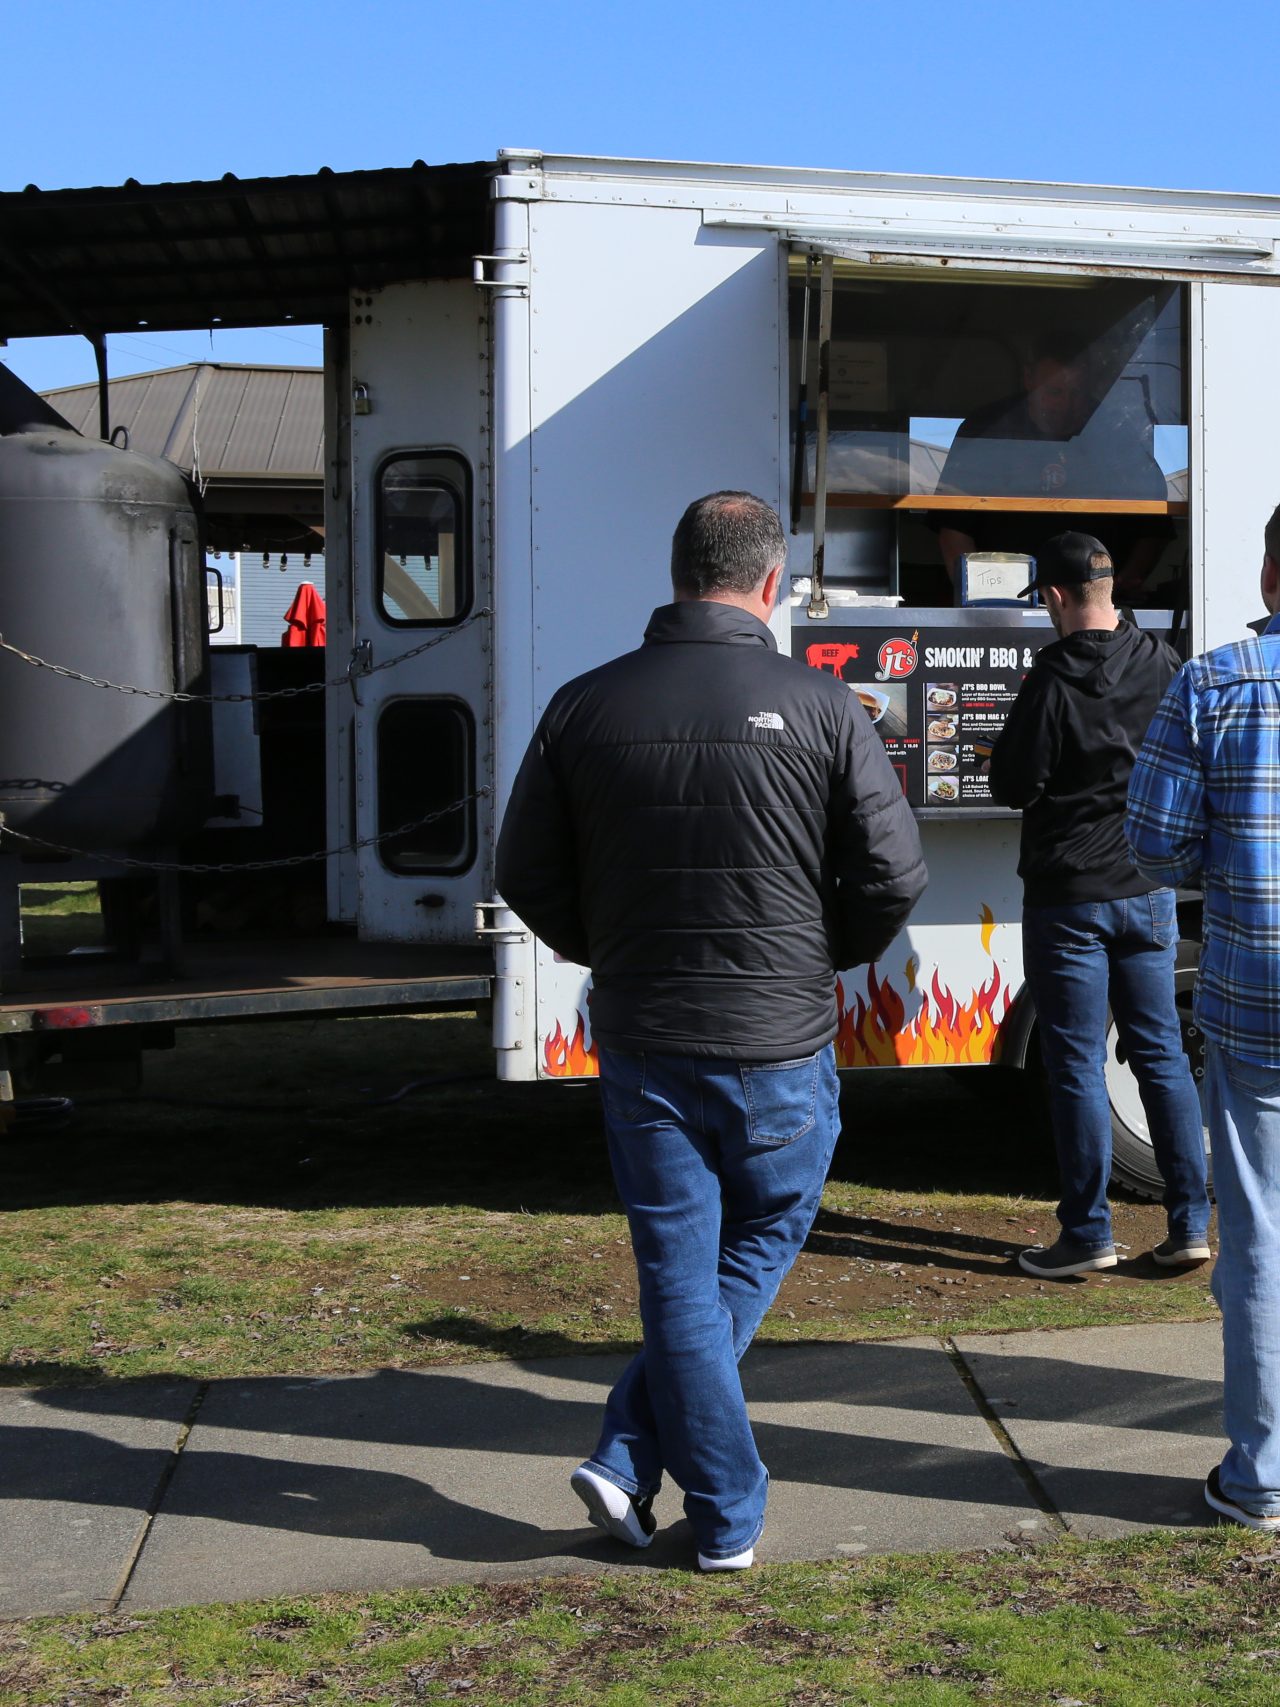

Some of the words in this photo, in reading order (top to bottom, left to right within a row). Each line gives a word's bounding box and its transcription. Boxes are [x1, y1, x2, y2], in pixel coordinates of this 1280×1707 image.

[977, 569, 1002, 588] Tips
[821, 648, 840, 657] BEEF
[924, 647, 985, 668] SMOKIN'
[989, 647, 1018, 670] BBQ
[1022, 647, 1033, 668] &
[874, 646, 914, 682] jt's
[747, 716, 773, 724] NORTH
[975, 713, 986, 721] BBQ
